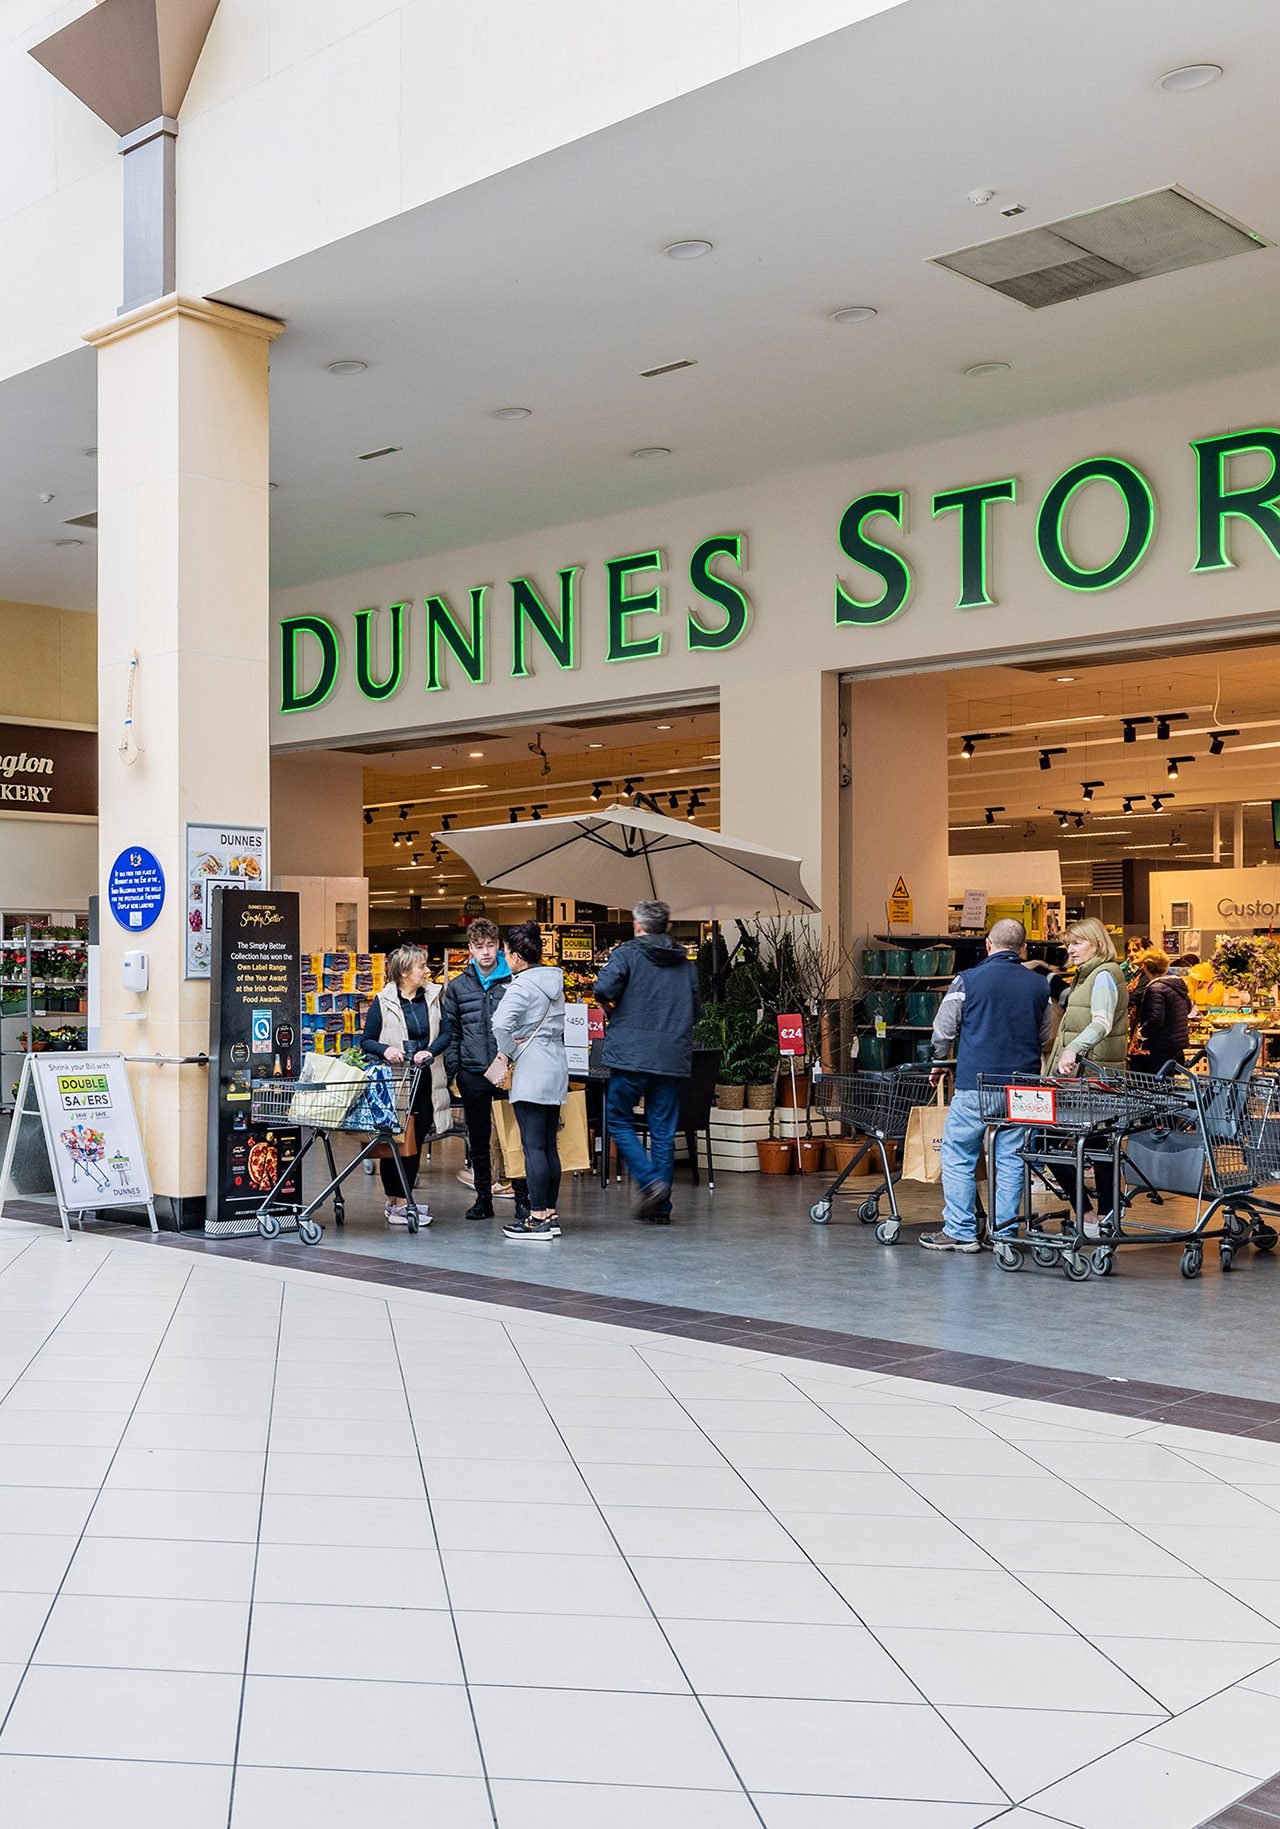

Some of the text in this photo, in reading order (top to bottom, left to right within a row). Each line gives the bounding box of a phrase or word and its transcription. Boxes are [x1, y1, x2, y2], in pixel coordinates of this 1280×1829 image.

[279, 532, 751, 714] DUNNES
[220, 834, 262, 847] DUNNES
[1217, 898, 1280, 917] Custo
[249, 942, 268, 951] Simply
[269, 942, 286, 950] Better
[564, 939, 590, 947] DOUBLE
[230, 952, 259, 960] Collection
[237, 963, 251, 971] Own
[268, 964, 287, 972] Range
[236, 974, 244, 982] of
[244, 974, 255, 982] the
[269, 974, 287, 982] Award
[267, 985, 288, 993] Quality
[781, 1028, 803, 1039] €24
[48, 1064, 69, 1072] Shrink
[71, 1064, 85, 1072] your
[61, 1078, 105, 1089] DOUBLE
[113, 1187, 141, 1196] DUNNES
